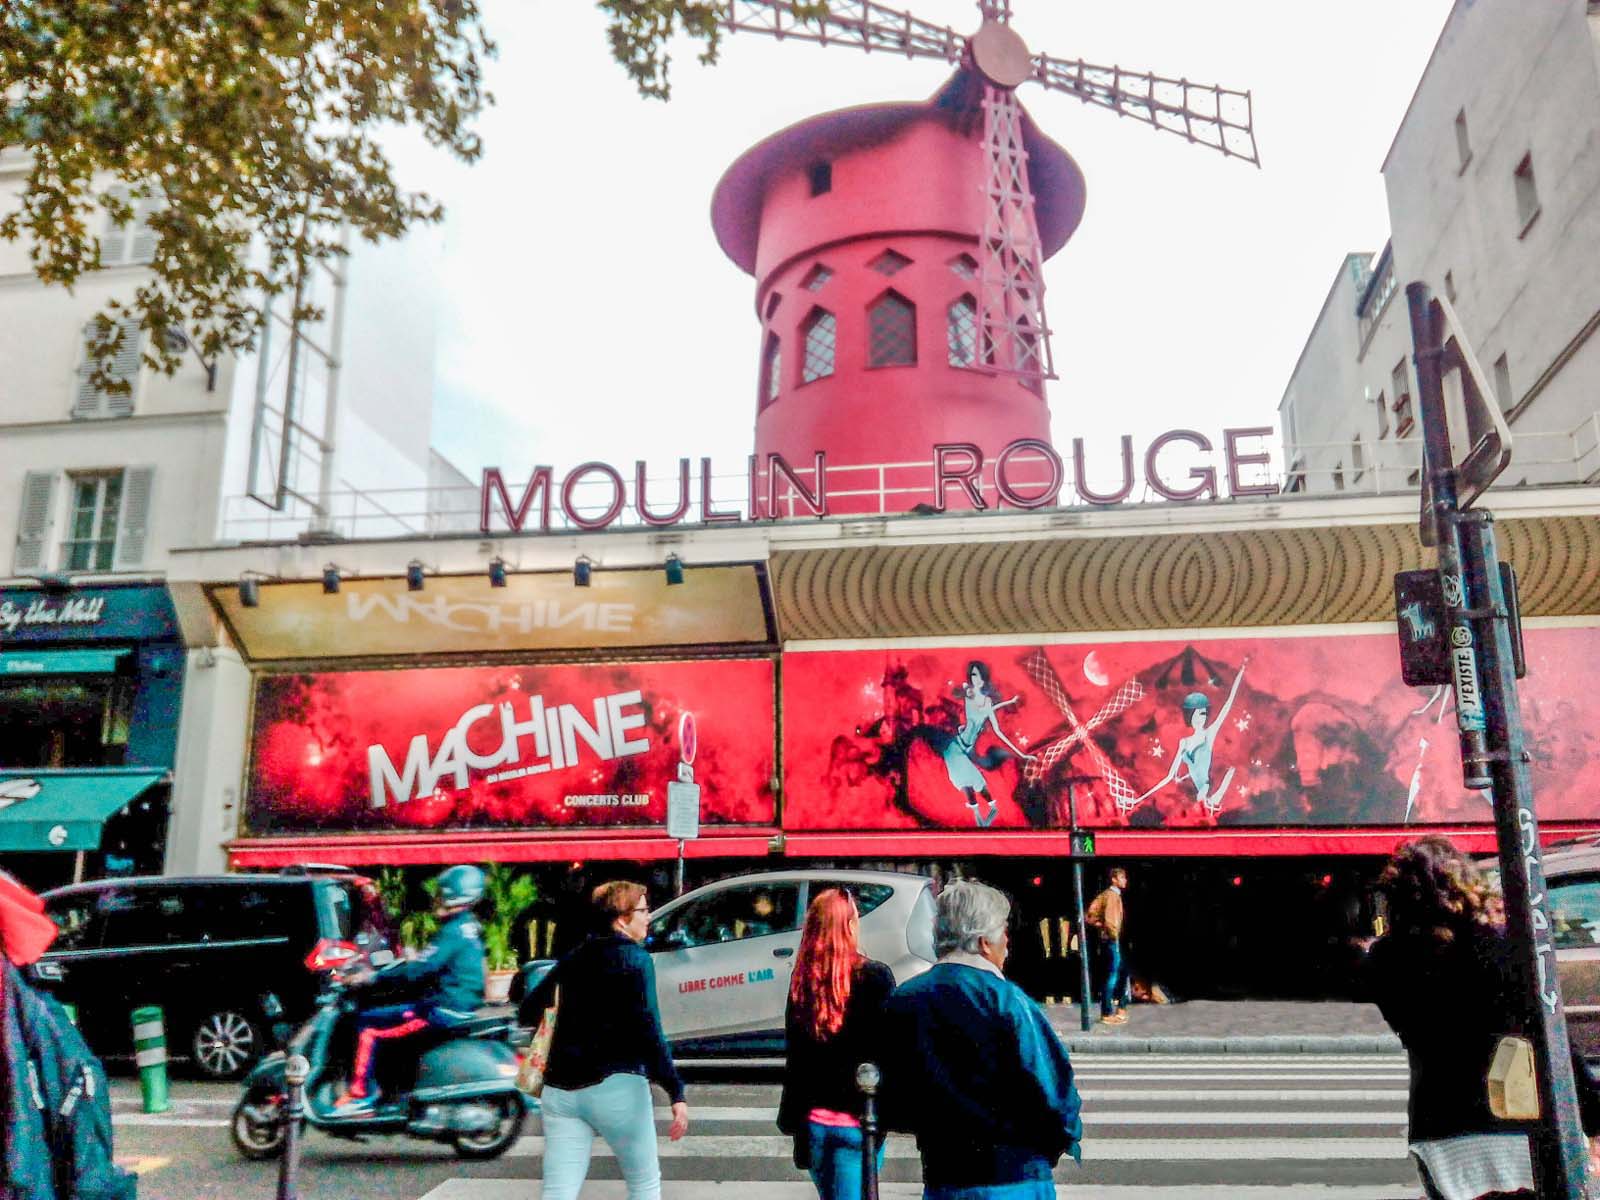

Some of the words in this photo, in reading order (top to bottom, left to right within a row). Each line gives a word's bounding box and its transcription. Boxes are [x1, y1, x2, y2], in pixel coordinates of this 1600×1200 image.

[480, 450, 826, 533] MOULIN
[933, 426, 1280, 511] ROUGE
[368, 690, 650, 809] MACHINE
[564, 794, 619, 807] CONCERTS
[621, 794, 650, 806] CLUB
[679, 978, 706, 993] LIBRE
[709, 973, 745, 989] COMME
[748, 968, 774, 983] L'AIR
